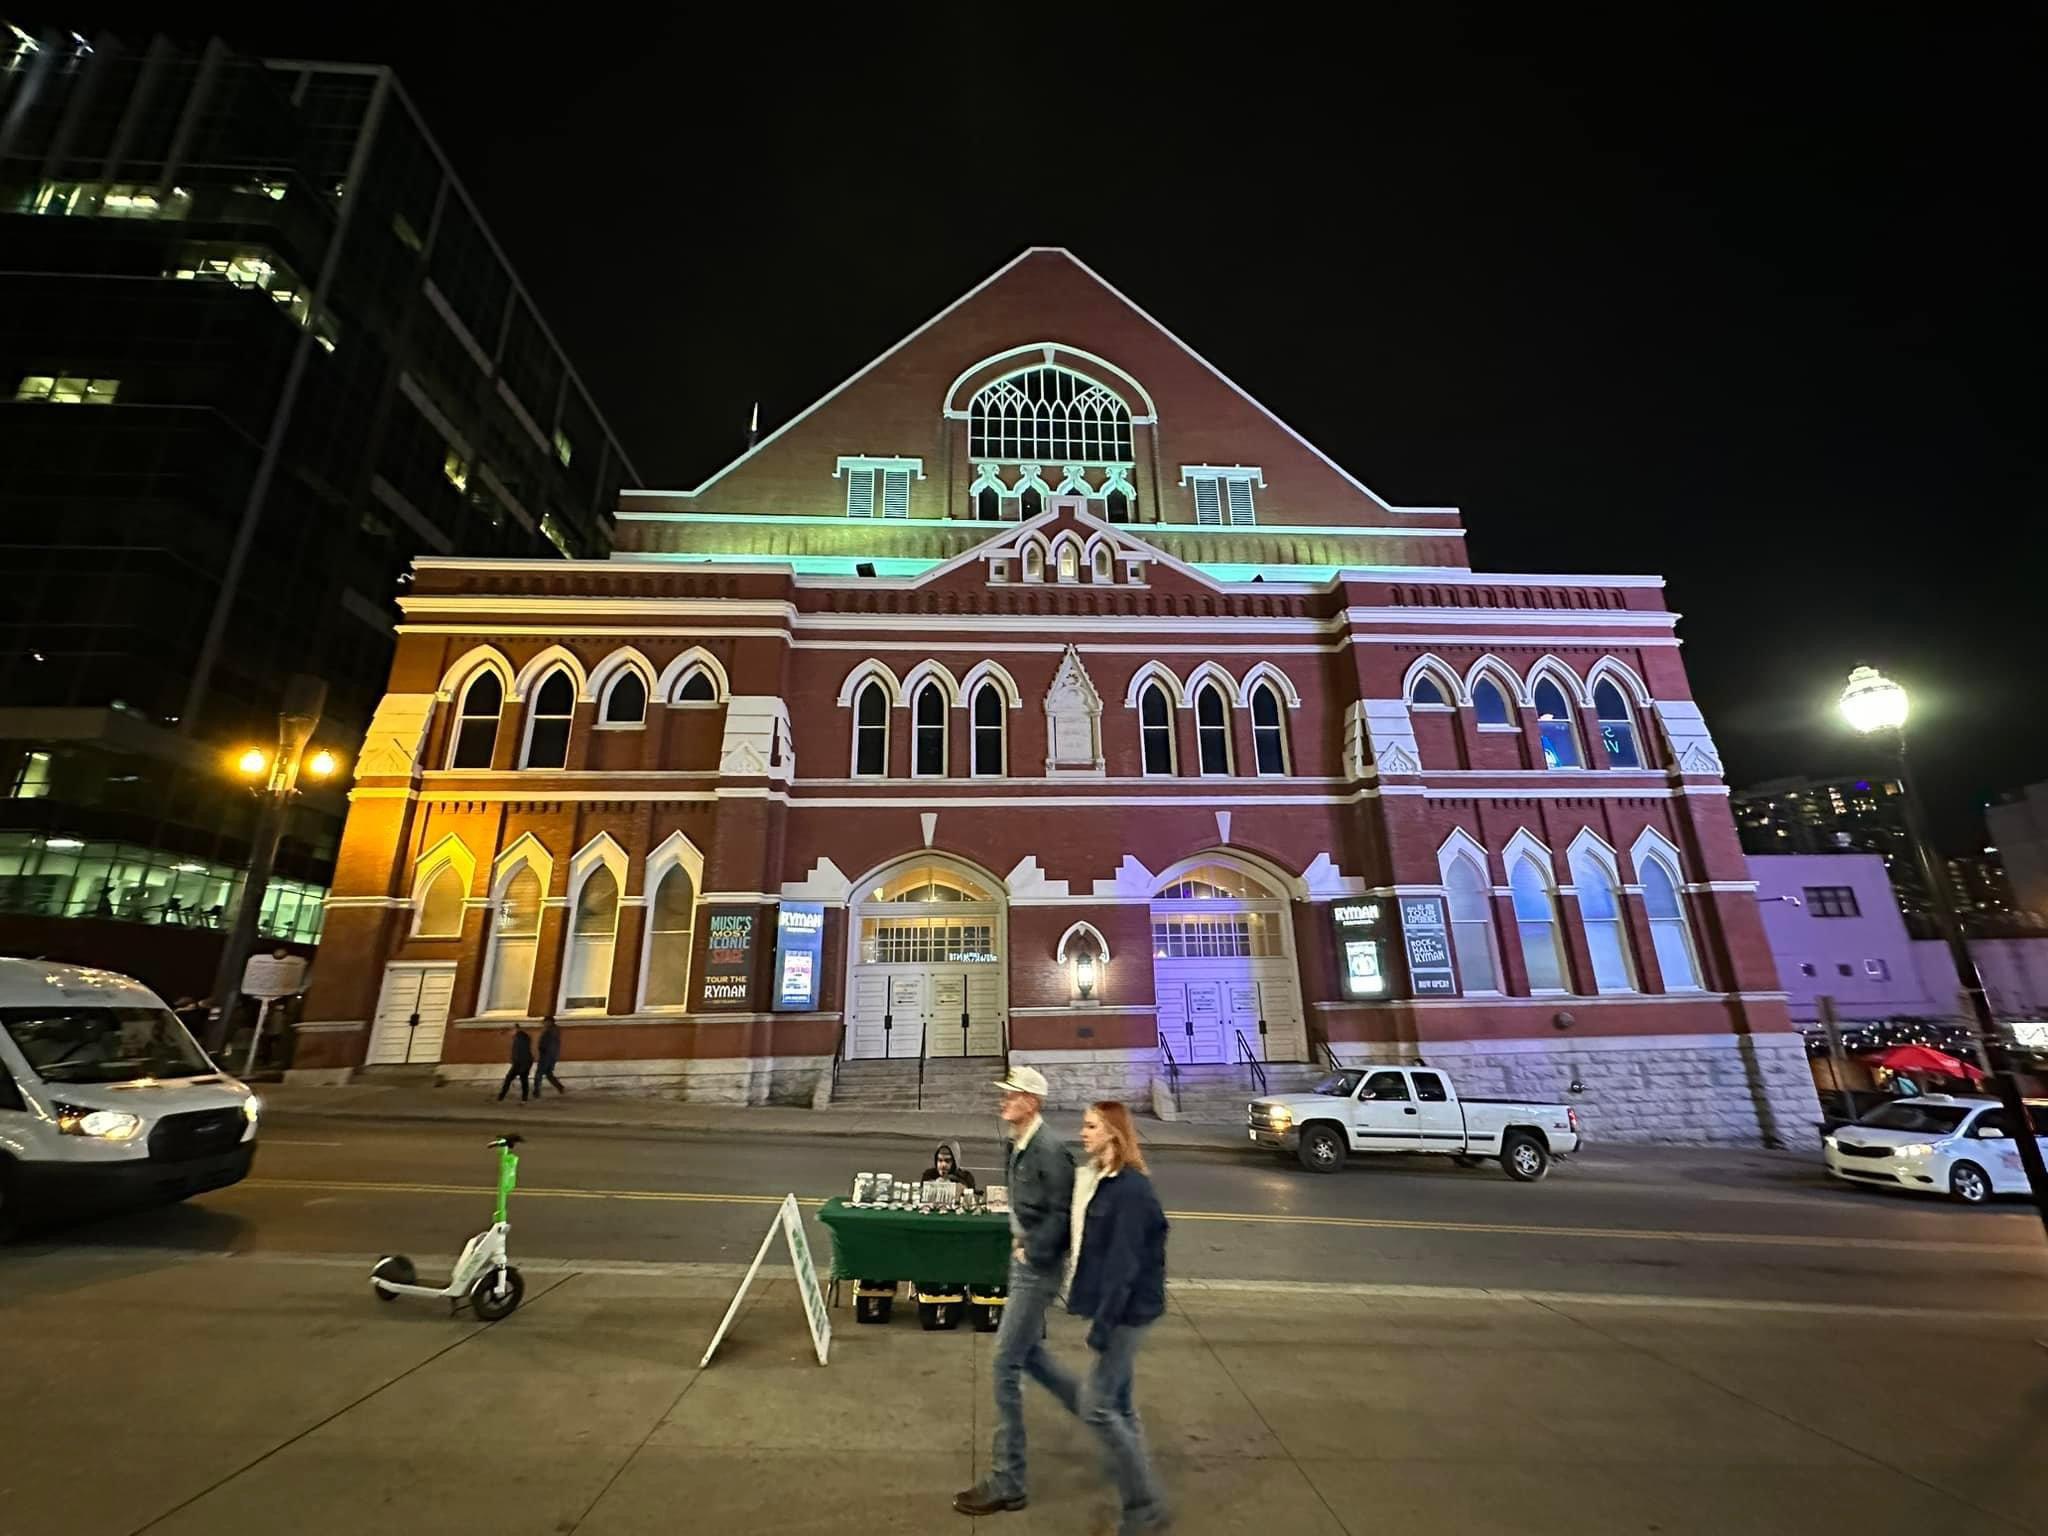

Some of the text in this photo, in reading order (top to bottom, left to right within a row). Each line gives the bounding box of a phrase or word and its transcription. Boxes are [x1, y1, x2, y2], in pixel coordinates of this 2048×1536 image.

[779, 911, 822, 927] RYMAN
[1334, 905, 1379, 921] RYMAN
[711, 916, 752, 931] MUSIC'S
[712, 930, 747, 938] MOST
[709, 937, 752, 949] ICONIC
[1415, 950, 1445, 963] RYMAN
[704, 985, 746, 998] RYMAN
